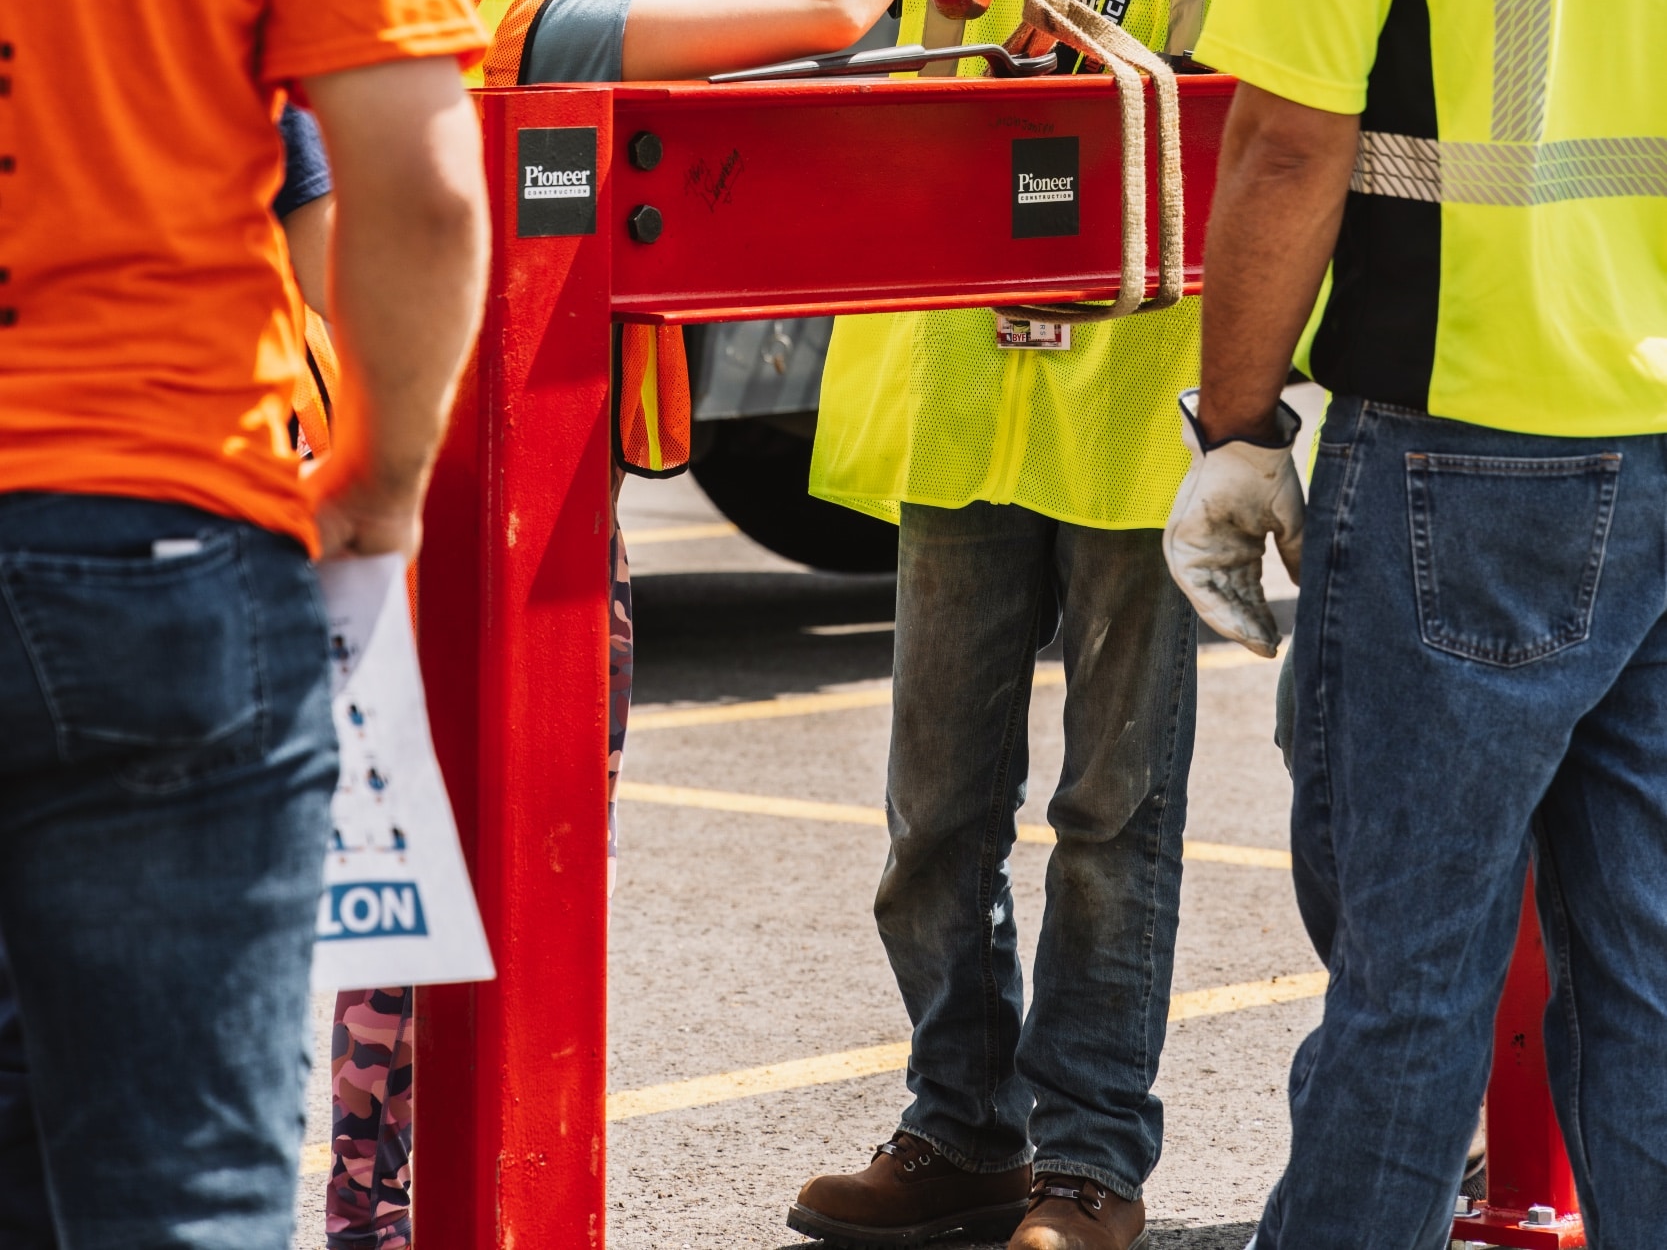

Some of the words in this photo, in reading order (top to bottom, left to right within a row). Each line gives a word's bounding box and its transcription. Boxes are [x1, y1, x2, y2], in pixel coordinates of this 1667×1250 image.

[524, 165, 590, 186] Pioneer
[1018, 173, 1073, 192] Pioneer
[527, 188, 588, 197] CONSTRUCTION
[1020, 193, 1072, 201] CONSTRUCTION
[1012, 333, 1026, 342] BYF
